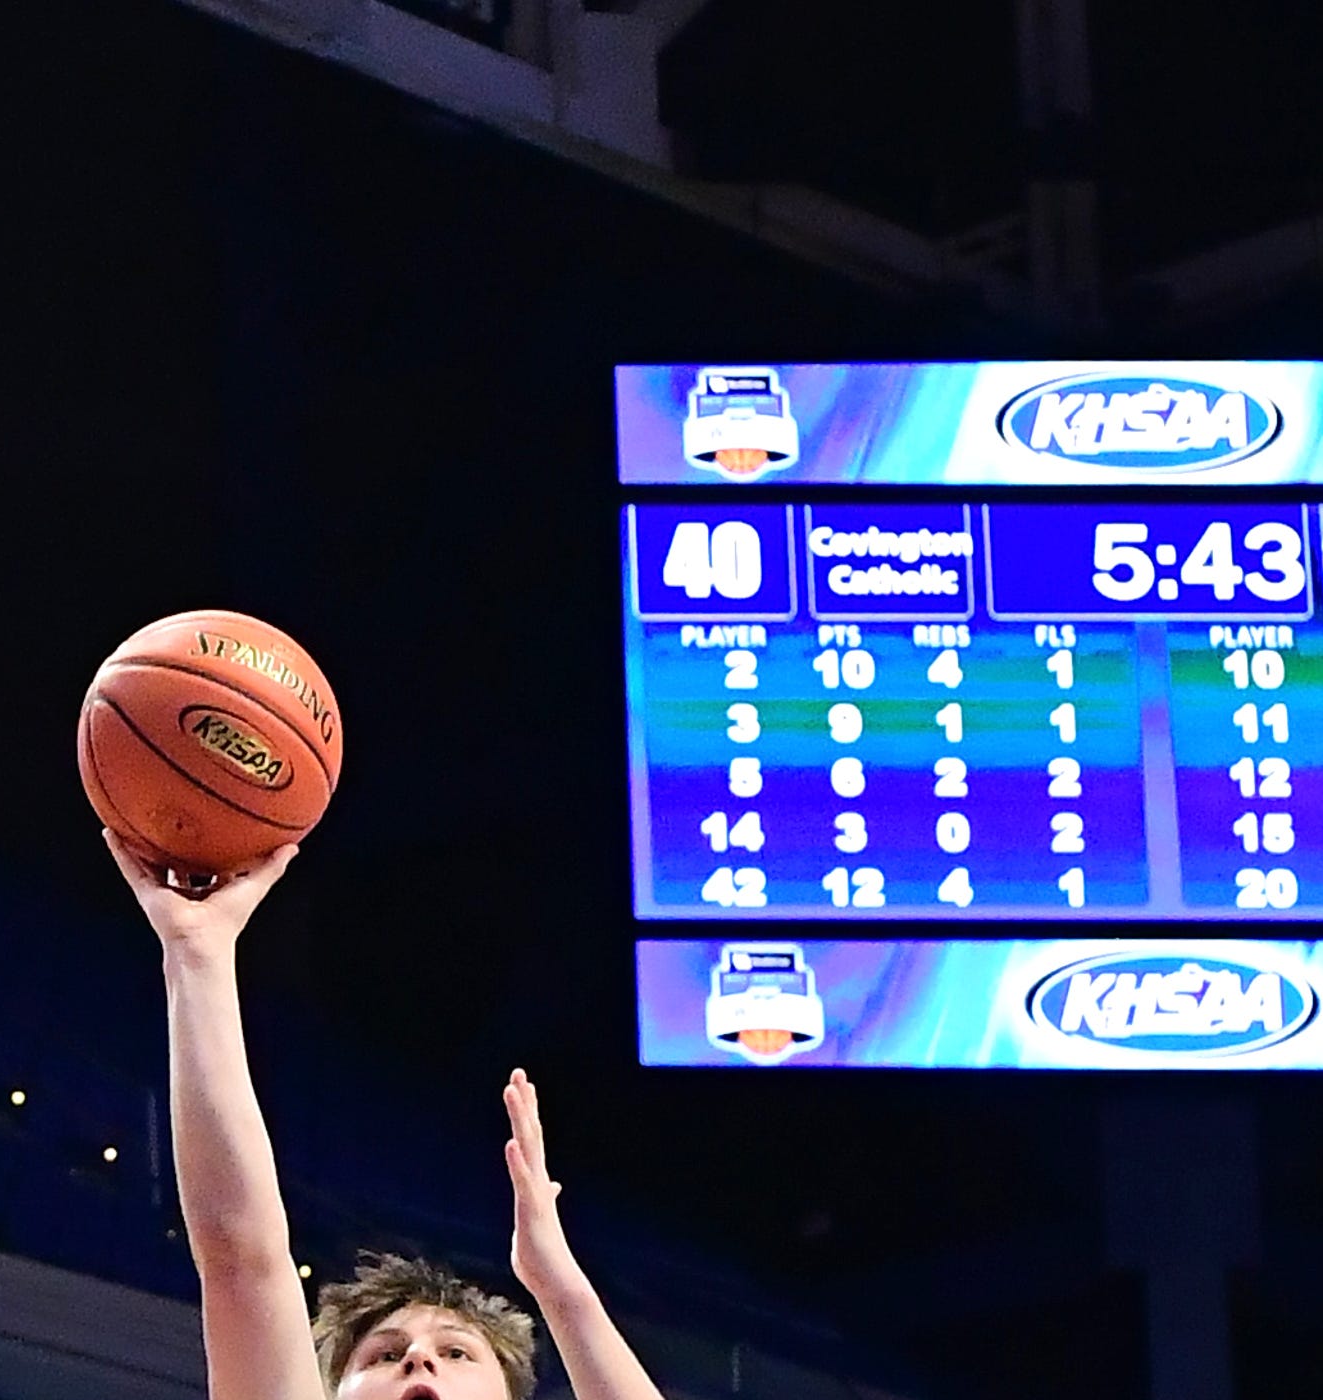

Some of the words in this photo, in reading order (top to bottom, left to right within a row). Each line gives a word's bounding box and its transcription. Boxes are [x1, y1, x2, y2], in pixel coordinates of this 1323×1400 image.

[1029, 383, 1250, 455] KHSAA
[664, 521, 762, 599] 40
[808, 525, 974, 563] Covington
[1093, 522, 1305, 601] 5:43
[827, 563, 960, 595] Catholic
[681, 625, 767, 648] PLAYER
[818, 624, 867, 648] PTS
[913, 624, 971, 648] REBS
[1034, 624, 1076, 648] FLS
[1209, 625, 1294, 648] PLAYER
[190, 630, 335, 744] SPALDING
[725, 650, 758, 689] 2
[813, 650, 875, 689] 10
[928, 649, 963, 688] 4
[1047, 649, 1073, 688] 1
[1224, 650, 1285, 689] 10
[727, 703, 761, 743] 3
[828, 703, 863, 743] 9
[936, 703, 963, 742] 1
[1050, 703, 1077, 742] 1
[1233, 703, 1290, 742] 11
[192, 714, 284, 784] KHSAA
[729, 758, 763, 797] 5
[934, 758, 968, 797] 2
[1048, 758, 1082, 797] 2
[1230, 757, 1292, 797] 12
[701, 812, 765, 852] 14
[834, 812, 868, 852] 3
[936, 812, 970, 853] 0
[1051, 813, 1084, 853] 2
[1233, 812, 1295, 853] 15
[702, 867, 767, 907] 42
[823, 868, 885, 907] 12
[938, 868, 973, 907] 4
[1059, 868, 1084, 908] 1
[1236, 868, 1299, 909] 20
[1059, 963, 1285, 1039] KHSAA
